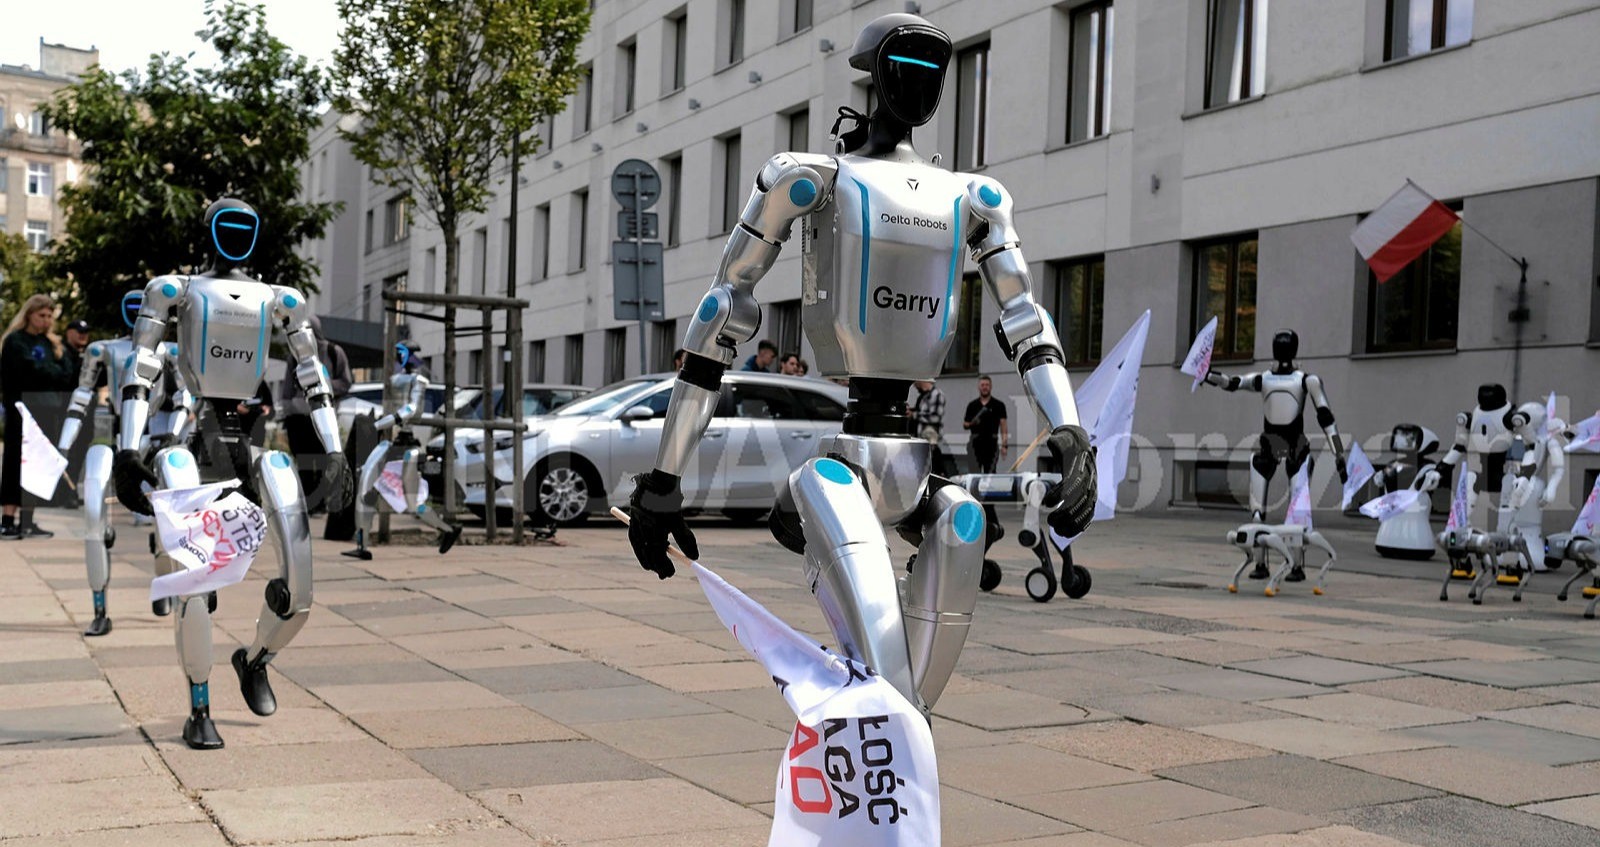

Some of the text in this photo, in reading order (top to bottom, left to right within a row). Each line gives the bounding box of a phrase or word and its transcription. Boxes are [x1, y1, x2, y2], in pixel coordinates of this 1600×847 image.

[881, 213, 948, 231] Delta Robots
[873, 285, 940, 319] Garry
[210, 345, 254, 363] Garry
[858, 715, 909, 826] ŁOŚĆ
